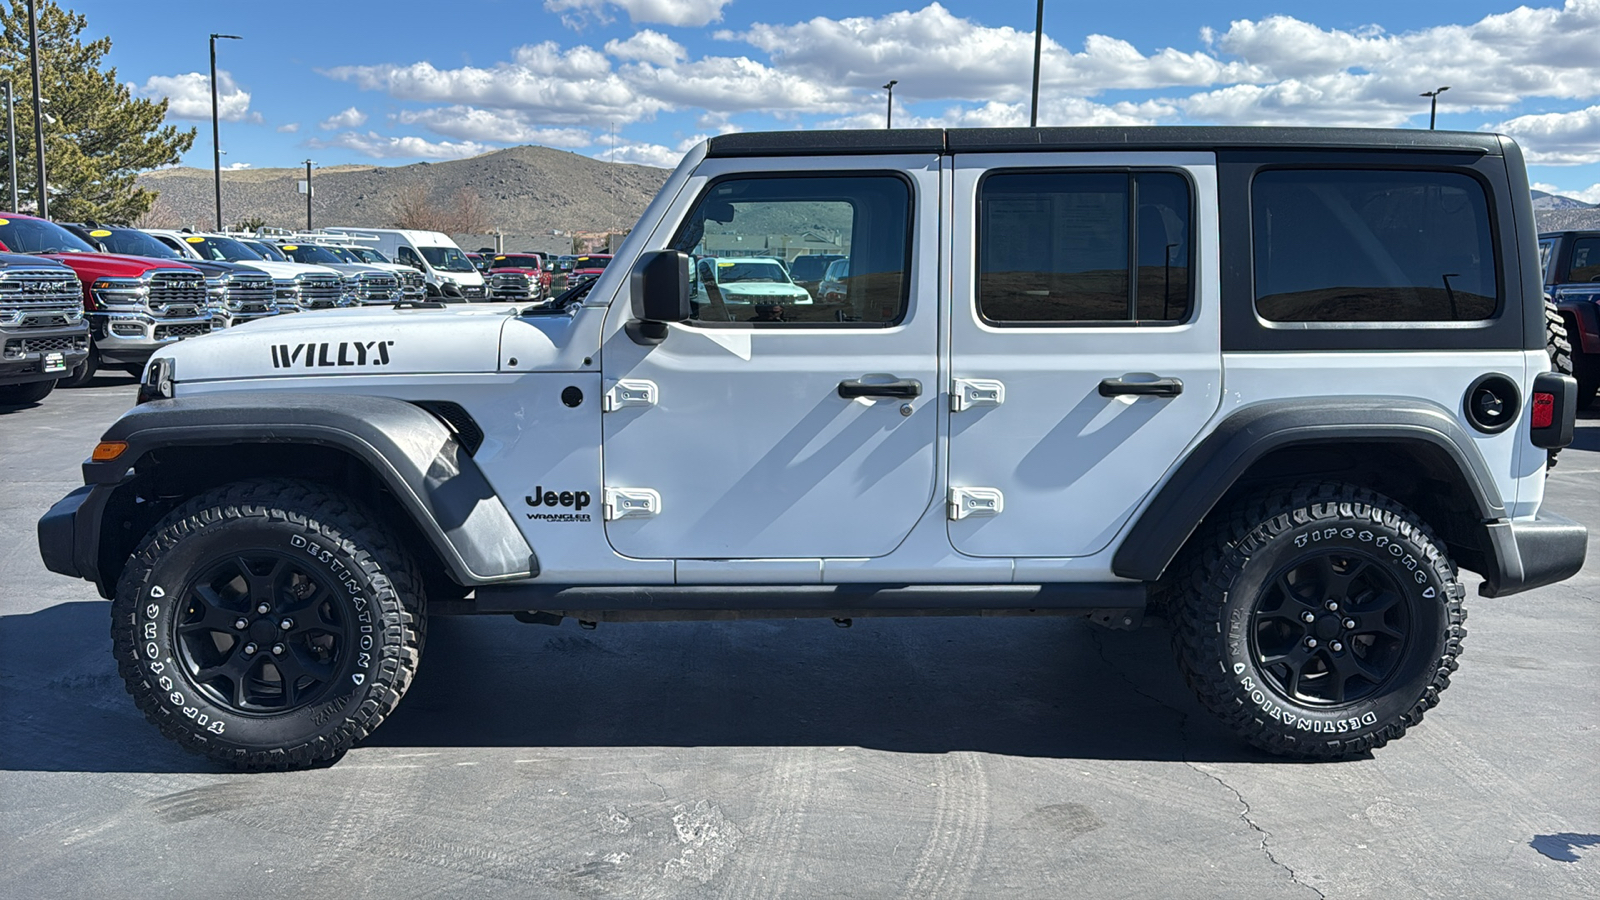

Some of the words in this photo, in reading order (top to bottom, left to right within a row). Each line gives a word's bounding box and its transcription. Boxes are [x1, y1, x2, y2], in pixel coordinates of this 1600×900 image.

[270, 340, 395, 369] WILLYS
[525, 485, 591, 511] Jeep
[1293, 527, 1429, 585] Firestone
[289, 533, 374, 669] DESTINATION
[144, 602, 226, 735] Firestone
[1240, 675, 1378, 733] DESTINATION
